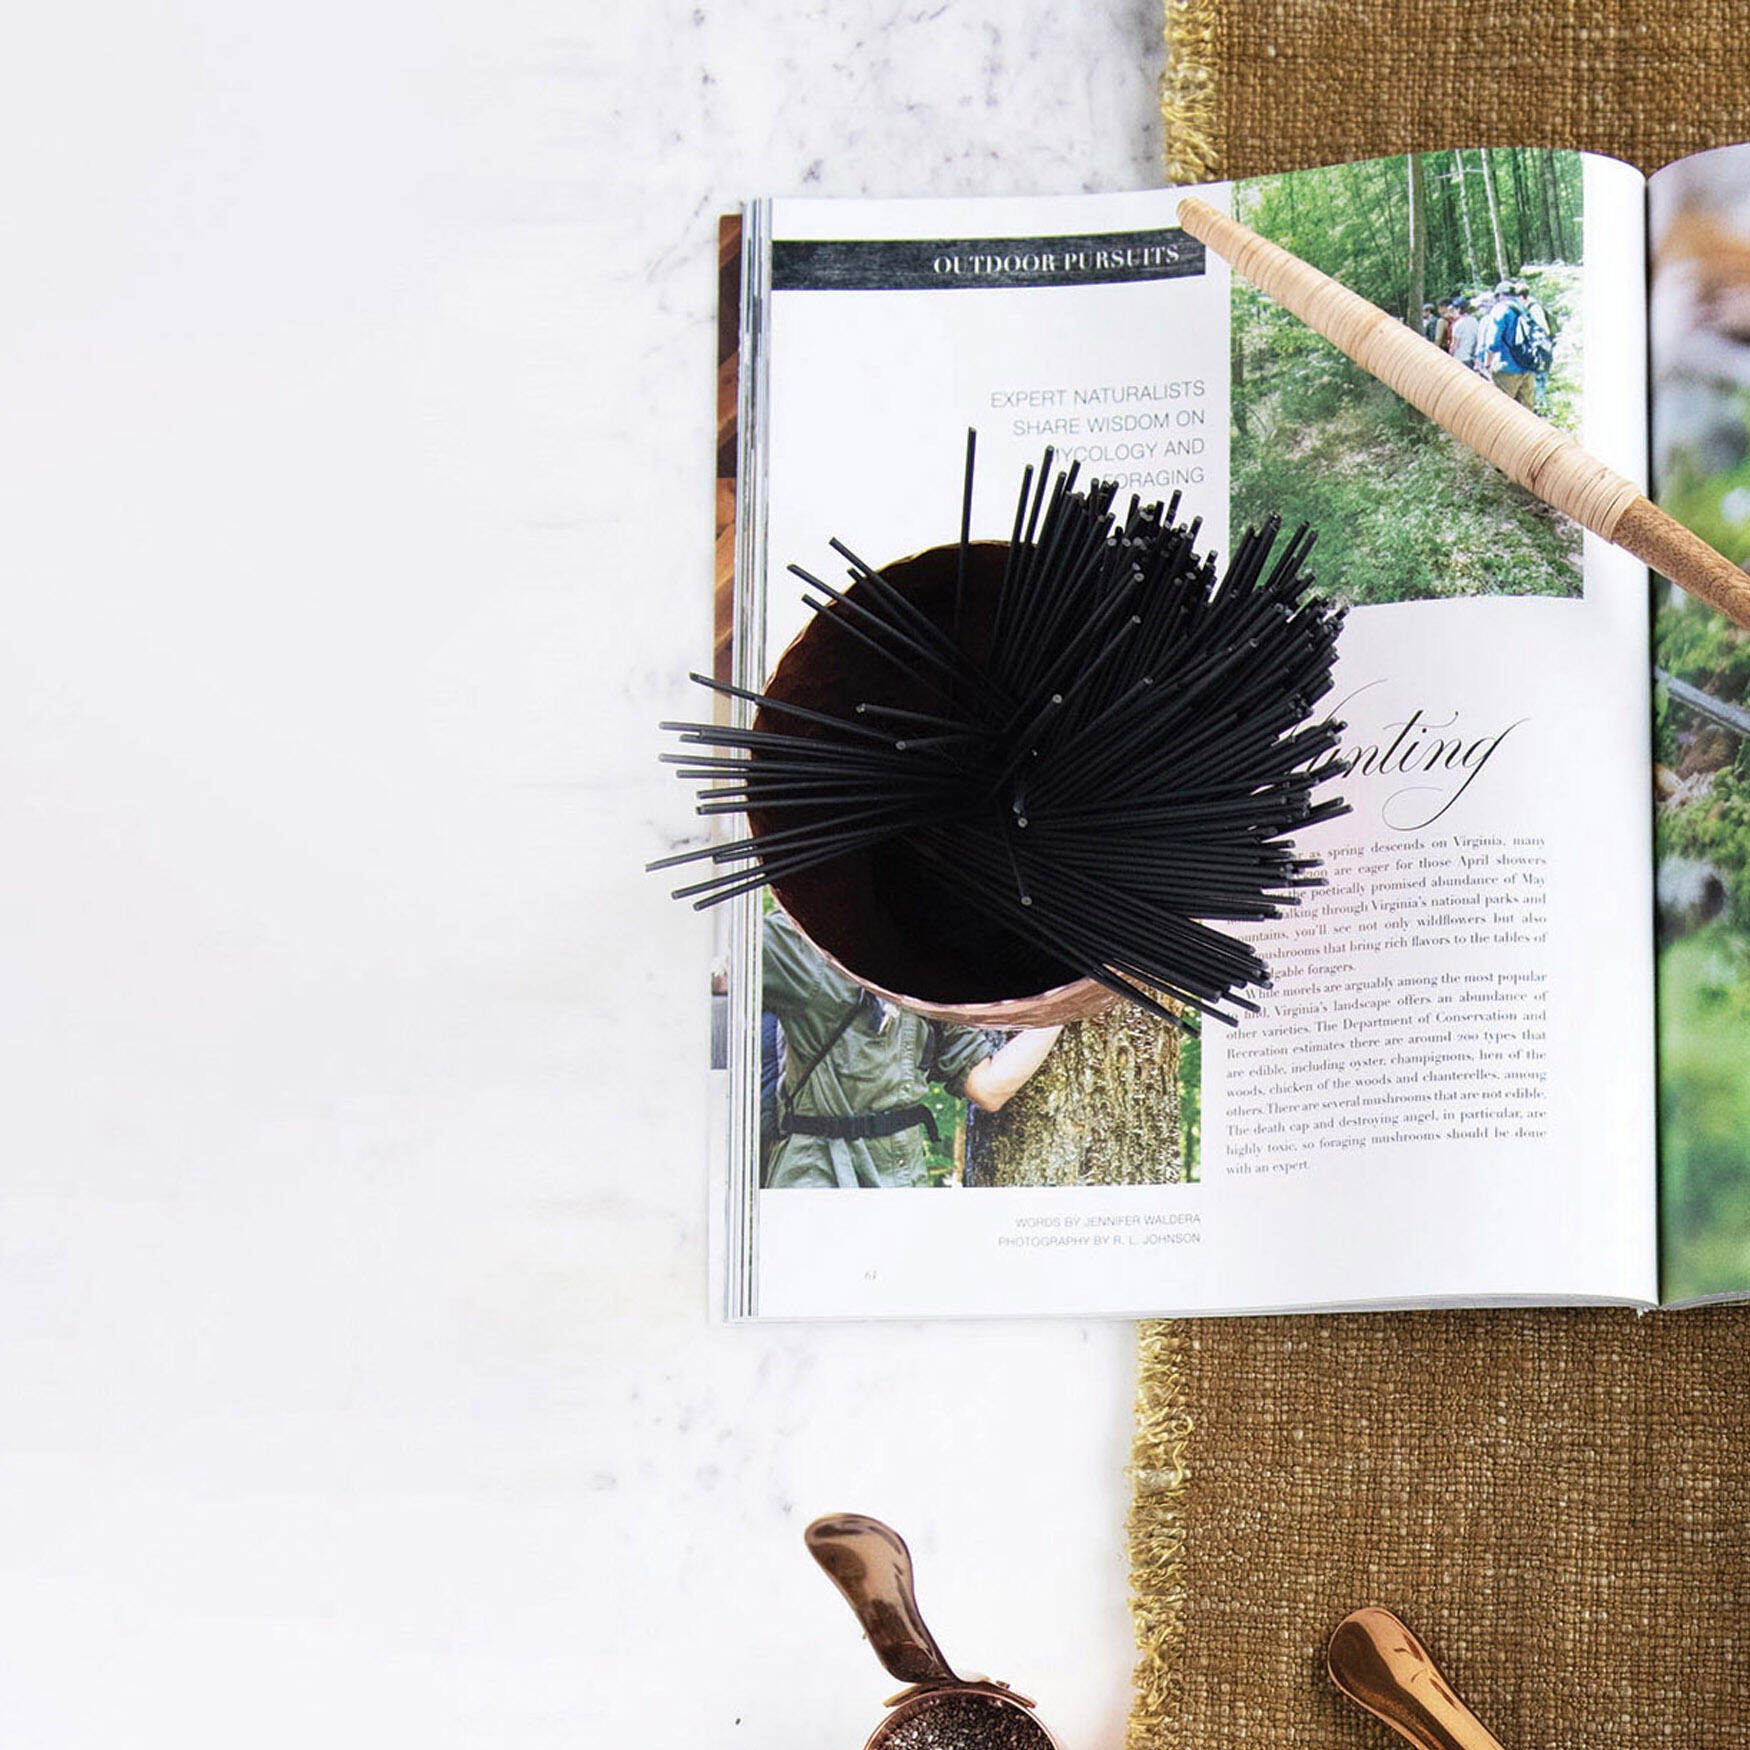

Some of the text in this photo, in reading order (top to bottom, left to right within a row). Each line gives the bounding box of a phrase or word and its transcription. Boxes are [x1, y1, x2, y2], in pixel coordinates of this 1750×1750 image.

[934, 244, 1180, 275] OUTDOOR PURSUITS
[990, 379, 1206, 409] EXPERT NATURALISTS
[1013, 409, 1205, 436] SHARE WISDOM ON
[1164, 438, 1205, 456] AND
[1327, 847, 1365, 860] spring
[1370, 839, 1425, 852] descends
[1512, 839, 1545, 847] many
[1357, 864, 1390, 875] eager
[1395, 859, 1414, 870] for
[1418, 858, 1452, 868] those
[1496, 854, 1547, 864] showers
[1311, 873, 1545, 900] poetically promised abundance of May
[1322, 893, 1547, 915] through Virginia's national parks and
[1295, 925, 1327, 941] you'll
[1358, 922, 1378, 931] not
[1384, 917, 1409, 931] only
[1416, 915, 1487, 926] wildflowers
[1493, 913, 1514, 923] but
[1521, 913, 1547, 923] also
[1323, 943, 1346, 953] that
[1349, 941, 1382, 952] bring
[1384, 937, 1408, 948] rich
[1411, 936, 1451, 946] flavors
[1470, 933, 1490, 943] the
[1493, 932, 1531, 942] tables
[1533, 934, 1547, 942] of
[1284, 984, 1321, 996] morels
[1324, 983, 1342, 992] are
[1345, 976, 1393, 992] arguably
[1397, 975, 1439, 989] among
[1440, 974, 1461, 983] the
[1464, 973, 1494, 982] most
[1497, 970, 1547, 985] popular
[1274, 991, 1547, 1017] Virginia's landscape offers abundance of
[1225, 1029, 1257, 1039] other
[1317, 1021, 1338, 1032] The
[1342, 1016, 1413, 1032] Department
[1417, 1014, 1430, 1023] of
[1435, 1010, 1518, 1022] Conservation
[1522, 1010, 1547, 1020] and
[1226, 1048, 1289, 1059] Recreation
[1292, 1042, 1345, 1053] estimates
[1349, 1038, 1381, 1048] there
[1407, 1031, 1452, 1043] around
[1484, 1032, 1517, 1043] types
[1521, 1030, 1546, 1040] that
[1291, 1060, 1345, 1073] including
[1507, 1050, 1521, 1059] of
[1525, 1050, 1546, 1059] the
[1268, 1082, 1313, 1093] chicken
[1316, 1079, 1329, 1089] of
[1332, 1078, 1351, 1088] the
[1355, 1074, 1392, 1086] woods
[1395, 1072, 1419, 1083] and
[1504, 1072, 1547, 1082] among
[1267, 1103, 1299, 1115] There
[1302, 1103, 1318, 1111] are
[1321, 1096, 1361, 1108] several
[1433, 1090, 1458, 1100] that
[1481, 1090, 1502, 1099] not
[1228, 1126, 1250, 1135] The
[1253, 1123, 1286, 1134] death
[1289, 1124, 1310, 1134] cap
[1313, 1118, 1335, 1129] and
[1338, 1116, 1399, 1127] destroying
[1226, 1144, 1261, 1156] highly
[1319, 1138, 1367, 1149] foraging
[1446, 1128, 1489, 1139] should
[1514, 1127, 1546, 1137] done
[1226, 1164, 1252, 1173] with
[1016, 1213, 1201, 1228] WORDS BY JENNIFER WALDERA
[998, 1236, 1090, 1247] PHOTOGRAPHY
[1094, 1236, 1110, 1246] BY
[1143, 1233, 1201, 1245] JOHNSON
